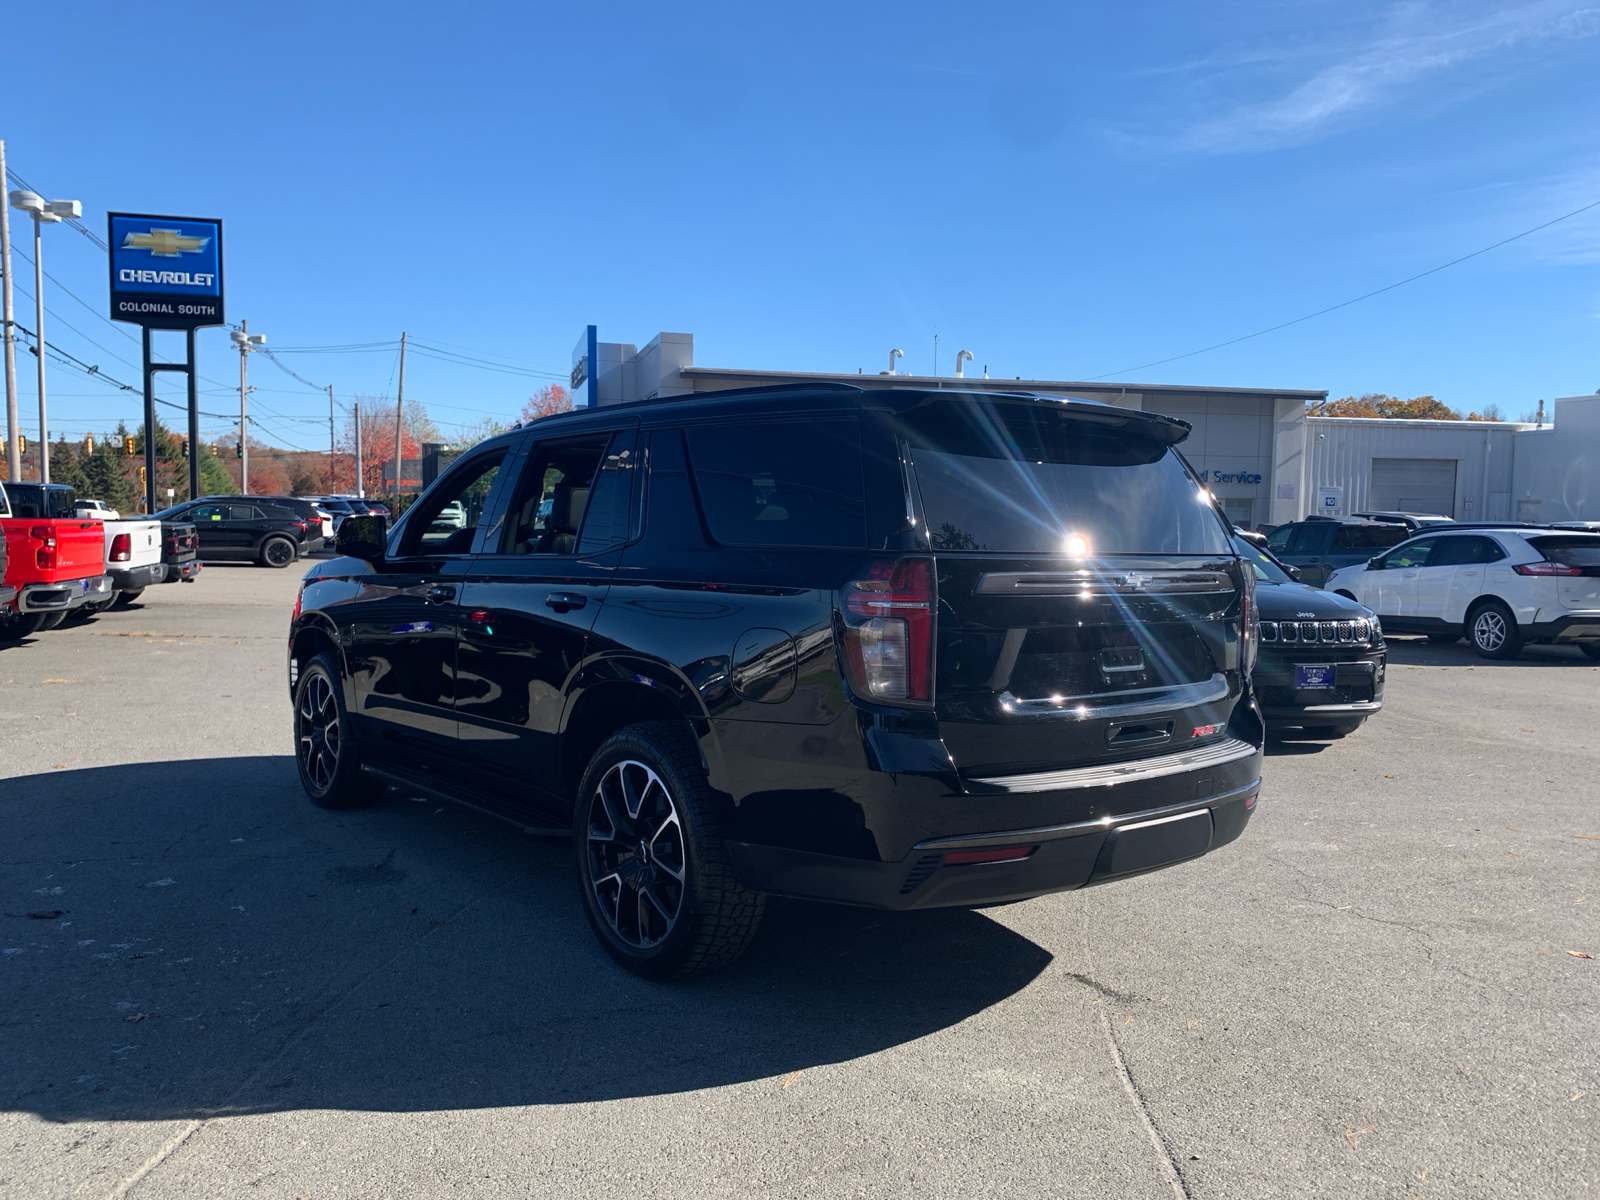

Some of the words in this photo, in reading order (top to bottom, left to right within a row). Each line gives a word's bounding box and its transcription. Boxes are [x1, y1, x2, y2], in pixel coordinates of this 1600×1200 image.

[119, 269, 215, 287] CHEVROLET
[119, 301, 175, 314] COLONIAL
[178, 304, 215, 316] SOUTH
[1213, 470, 1262, 484] Service
[1326, 497, 1335, 506] 10
[1191, 722, 1226, 738] RST
